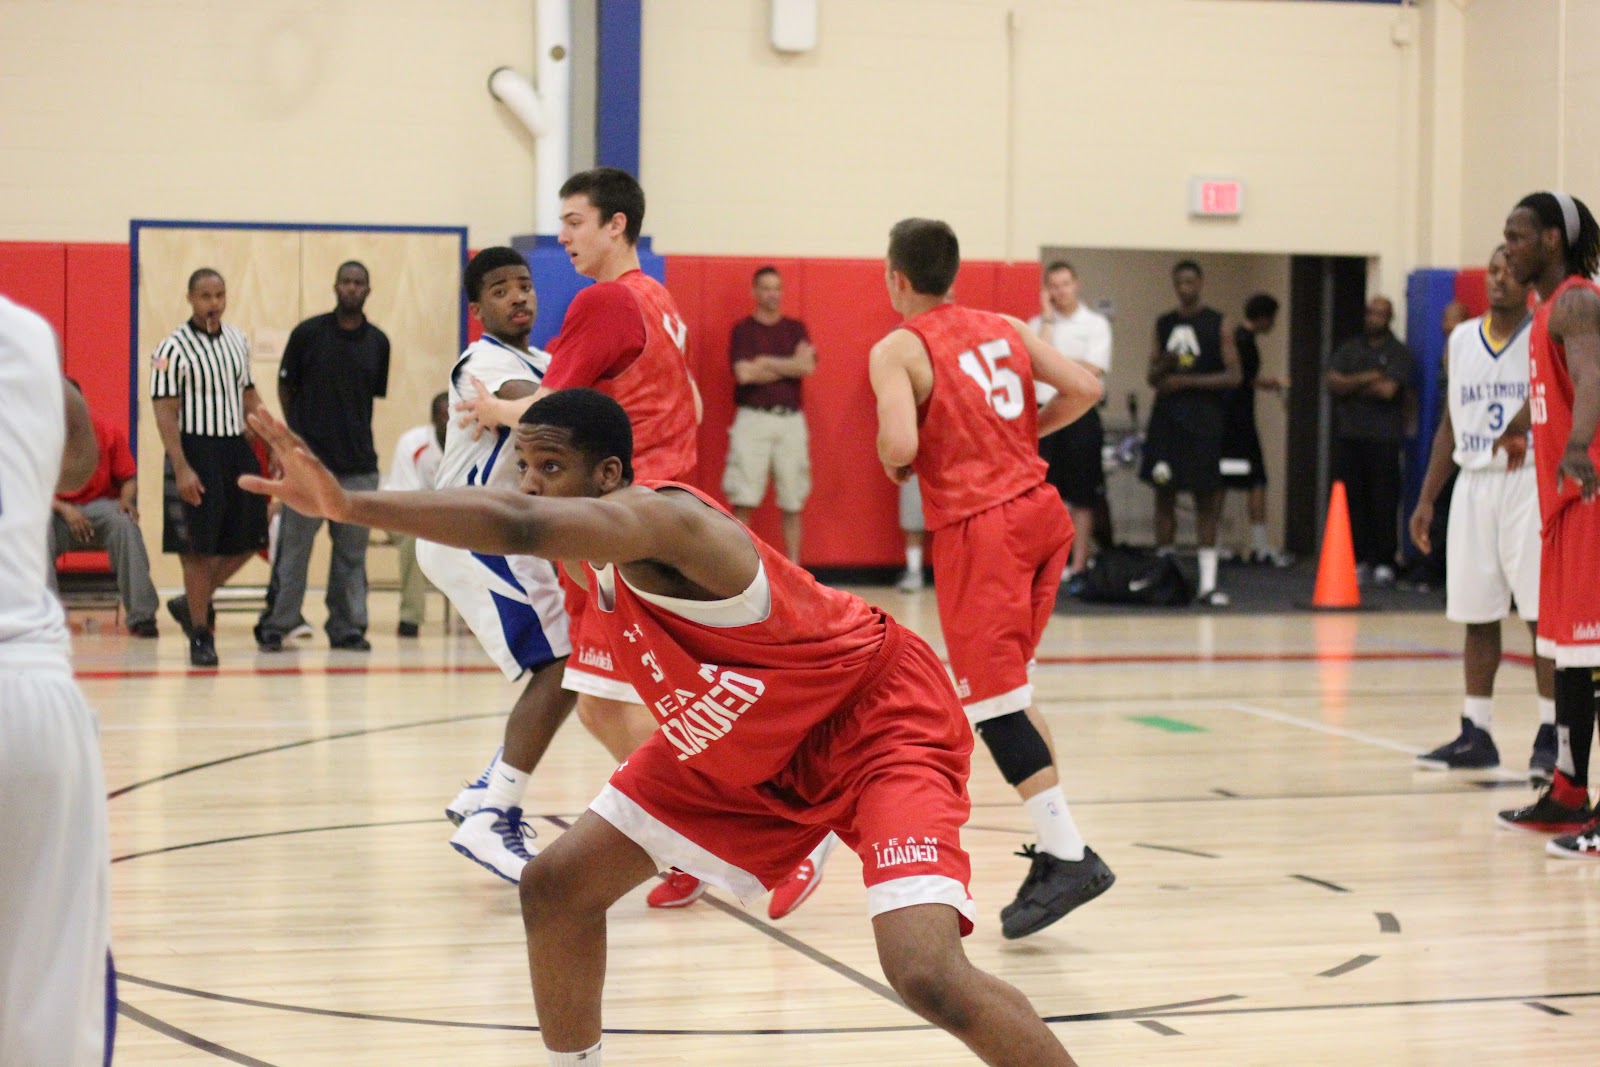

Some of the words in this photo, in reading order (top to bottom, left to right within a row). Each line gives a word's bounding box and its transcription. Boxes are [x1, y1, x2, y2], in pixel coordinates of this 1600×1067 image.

[958, 338, 1024, 420] 15
[1487, 403, 1505, 431] 3
[654, 663, 718, 717] EAM
[661, 671, 765, 761] OADED
[872, 837, 937, 851] TEAM
[876, 844, 938, 869] LOADED
